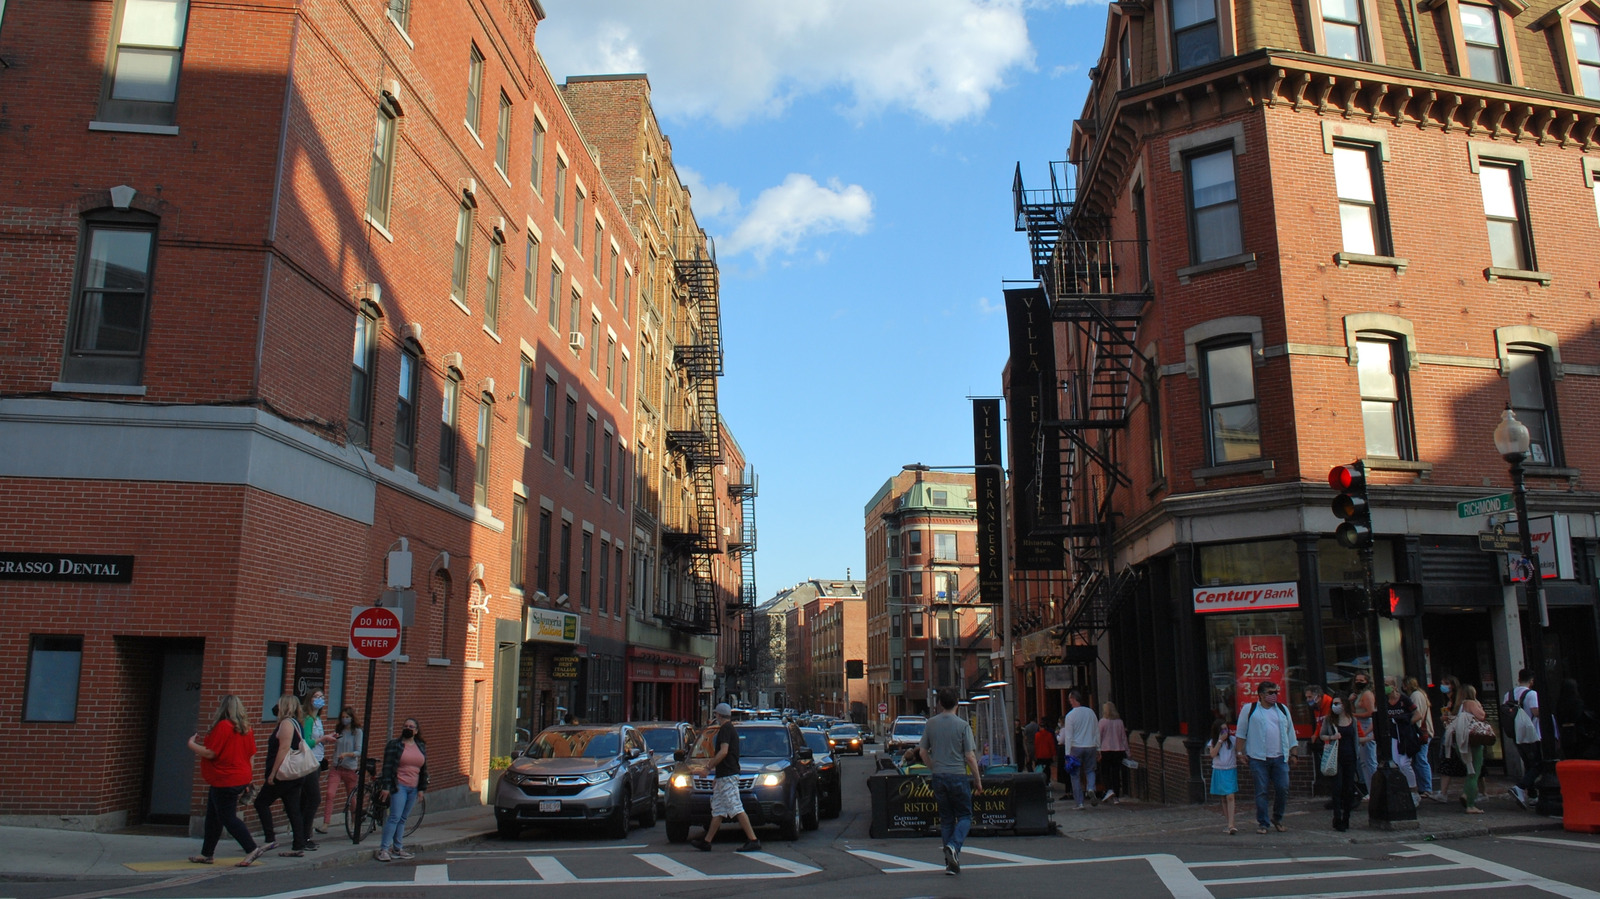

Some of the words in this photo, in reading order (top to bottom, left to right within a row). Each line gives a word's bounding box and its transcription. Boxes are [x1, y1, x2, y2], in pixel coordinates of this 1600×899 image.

[1023, 297, 1040, 372] VILLA
[982, 405, 993, 462] VILLA
[1463, 498, 1501, 516] RICHMOND
[986, 478, 998, 579] FRANCESCA
[58, 559, 120, 575] DENTAL
[1195, 589, 1264, 604] Century
[1264, 588, 1295, 600] Bank
[360, 618, 372, 626] DO
[376, 618, 393, 626] NOT
[361, 639, 389, 648] ENTER
[1252, 644, 1266, 652] Get
[307, 651, 319, 663] 279
[1240, 651, 1255, 659] low
[1256, 652, 1279, 660] rates.
[973, 802, 982, 811] &
[985, 801, 1005, 811] BAR
